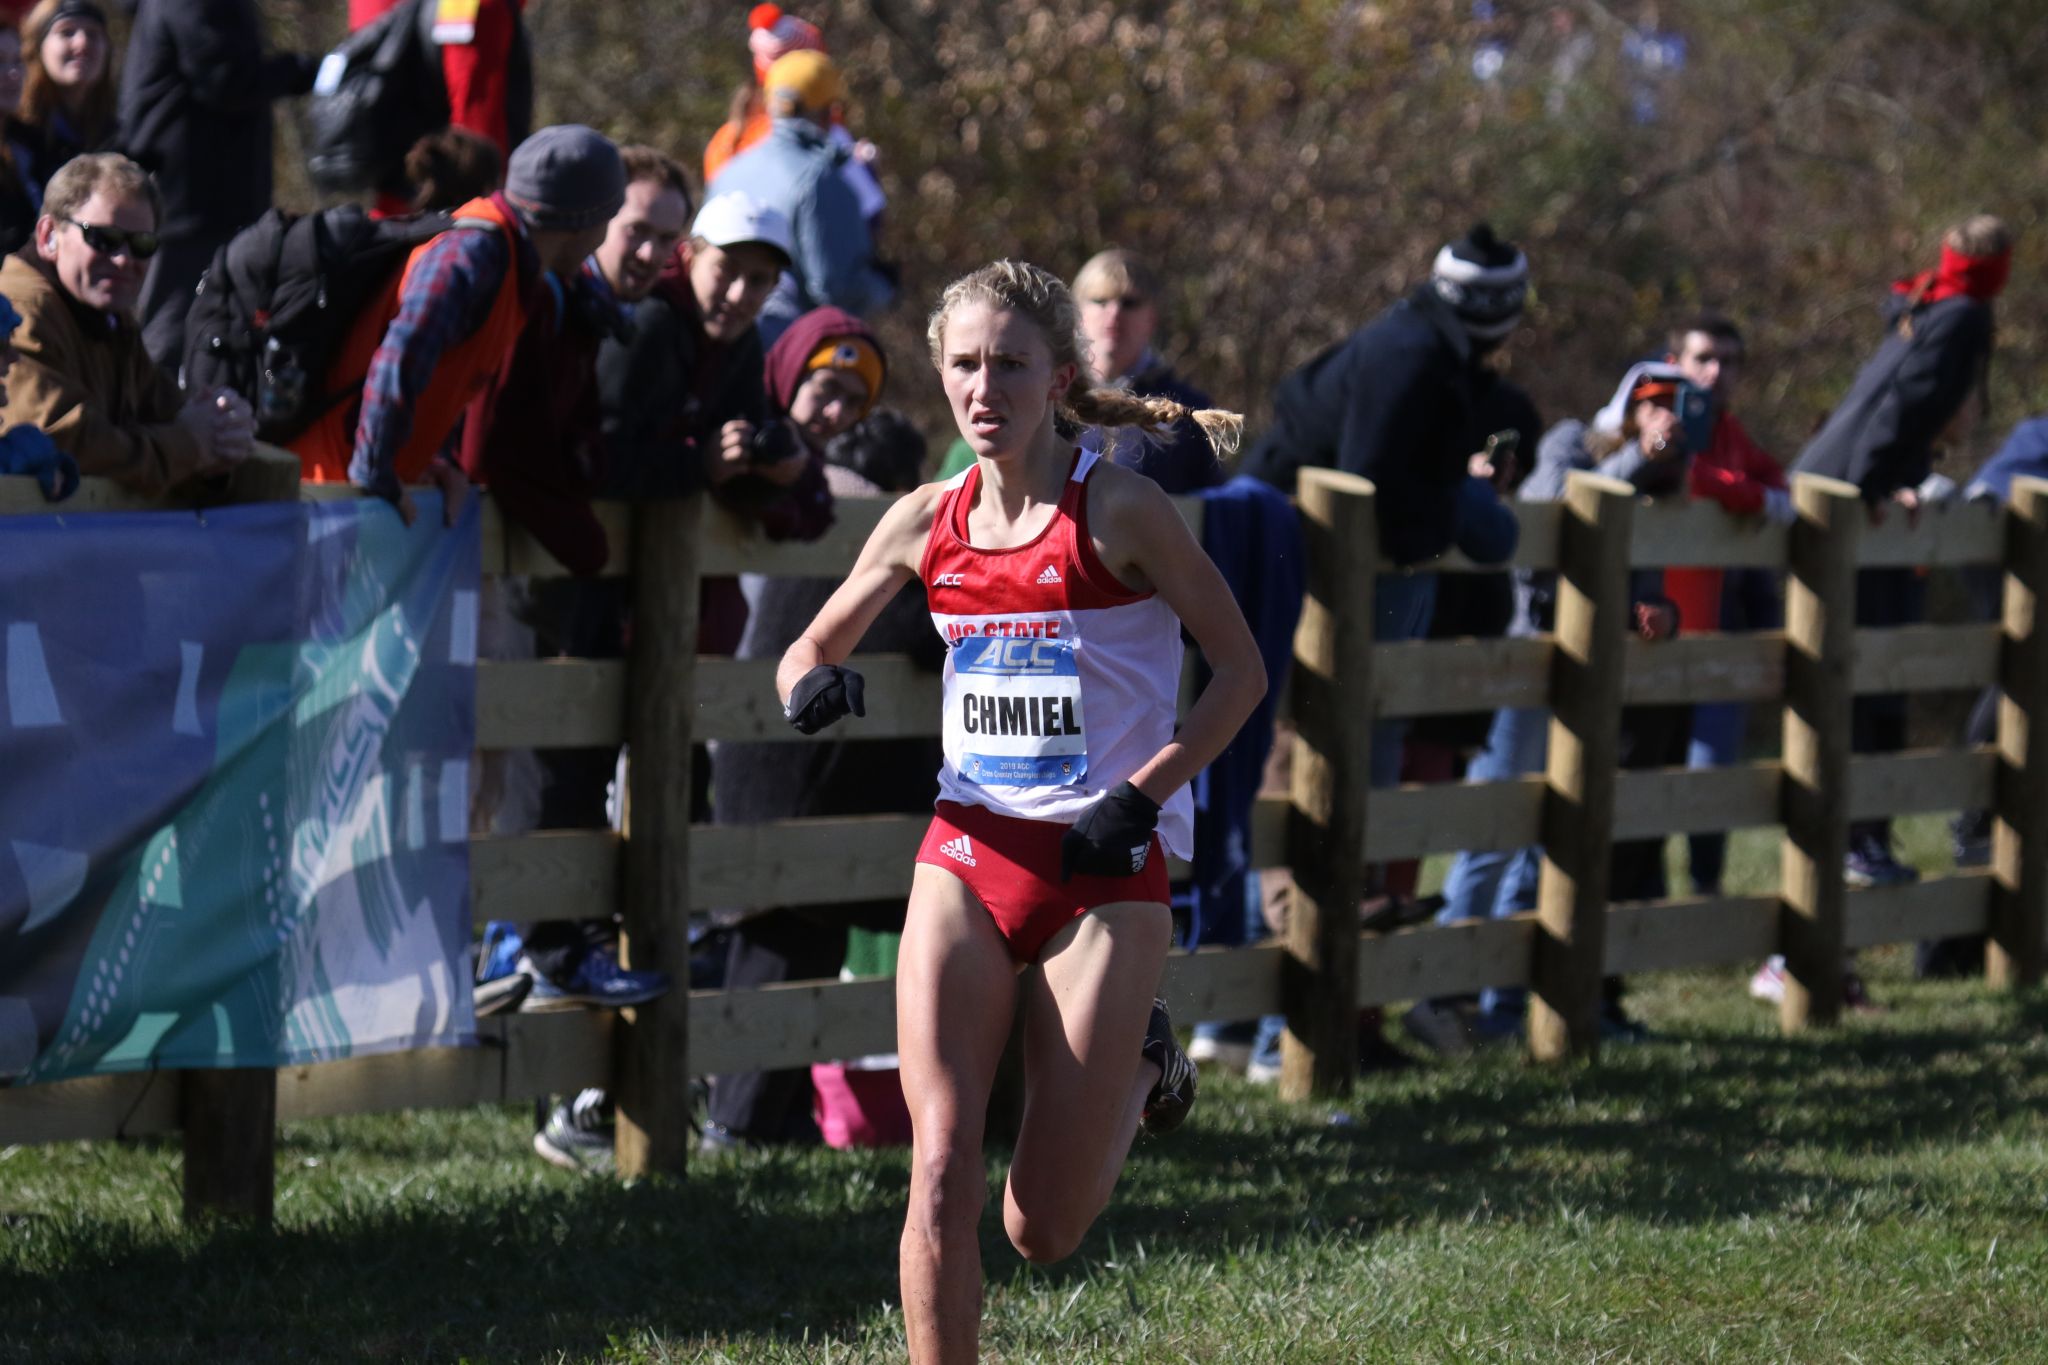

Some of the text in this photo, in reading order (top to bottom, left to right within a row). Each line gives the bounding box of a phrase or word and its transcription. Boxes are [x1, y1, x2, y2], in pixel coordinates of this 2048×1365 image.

[933, 573, 965, 586] ACC
[1036, 575, 1062, 585] adidas
[974, 638, 1057, 667] ACC
[963, 693, 1081, 736] CHMIEL
[1017, 762, 1030, 770] ACC
[940, 844, 977, 867] adidas
